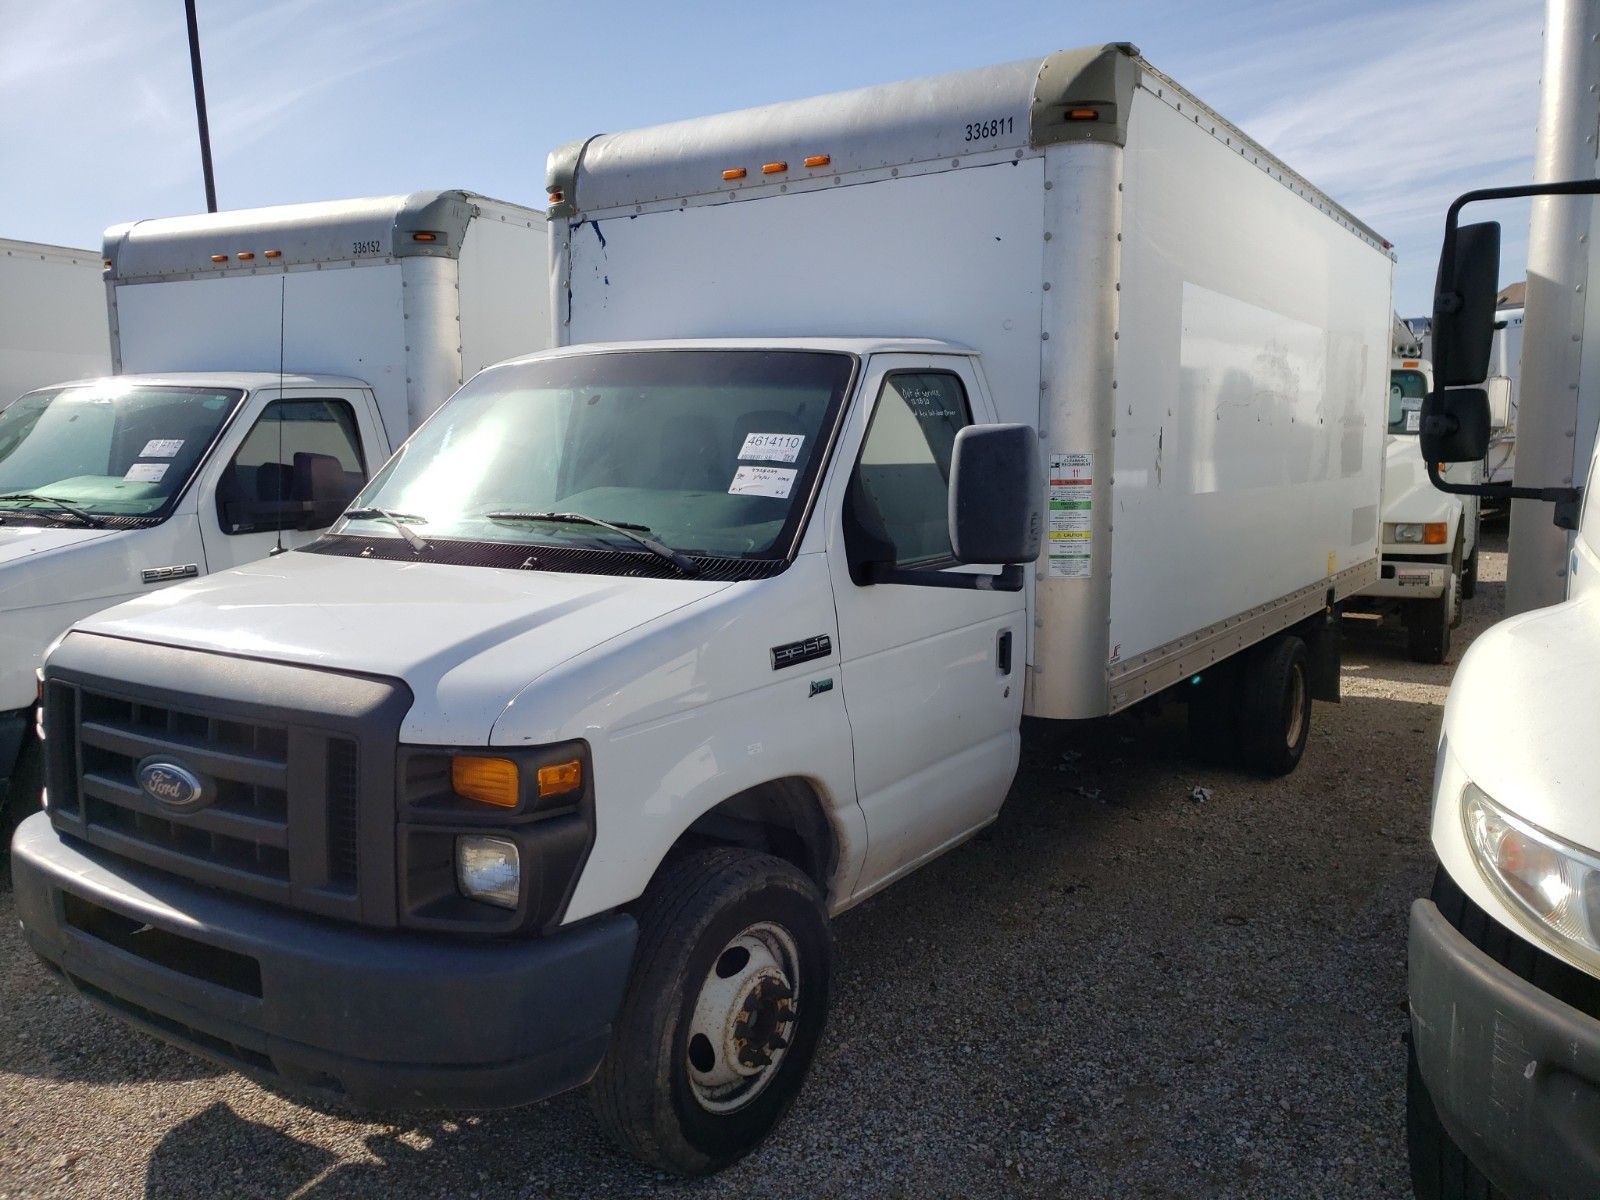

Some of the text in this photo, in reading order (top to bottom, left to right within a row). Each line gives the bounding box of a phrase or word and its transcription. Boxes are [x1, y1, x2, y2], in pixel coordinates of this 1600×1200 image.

[965, 116, 1014, 142] 336811
[352, 240, 381, 254] 336152
[748, 435, 800, 449] 4614110
[148, 769, 182, 798] Ford
